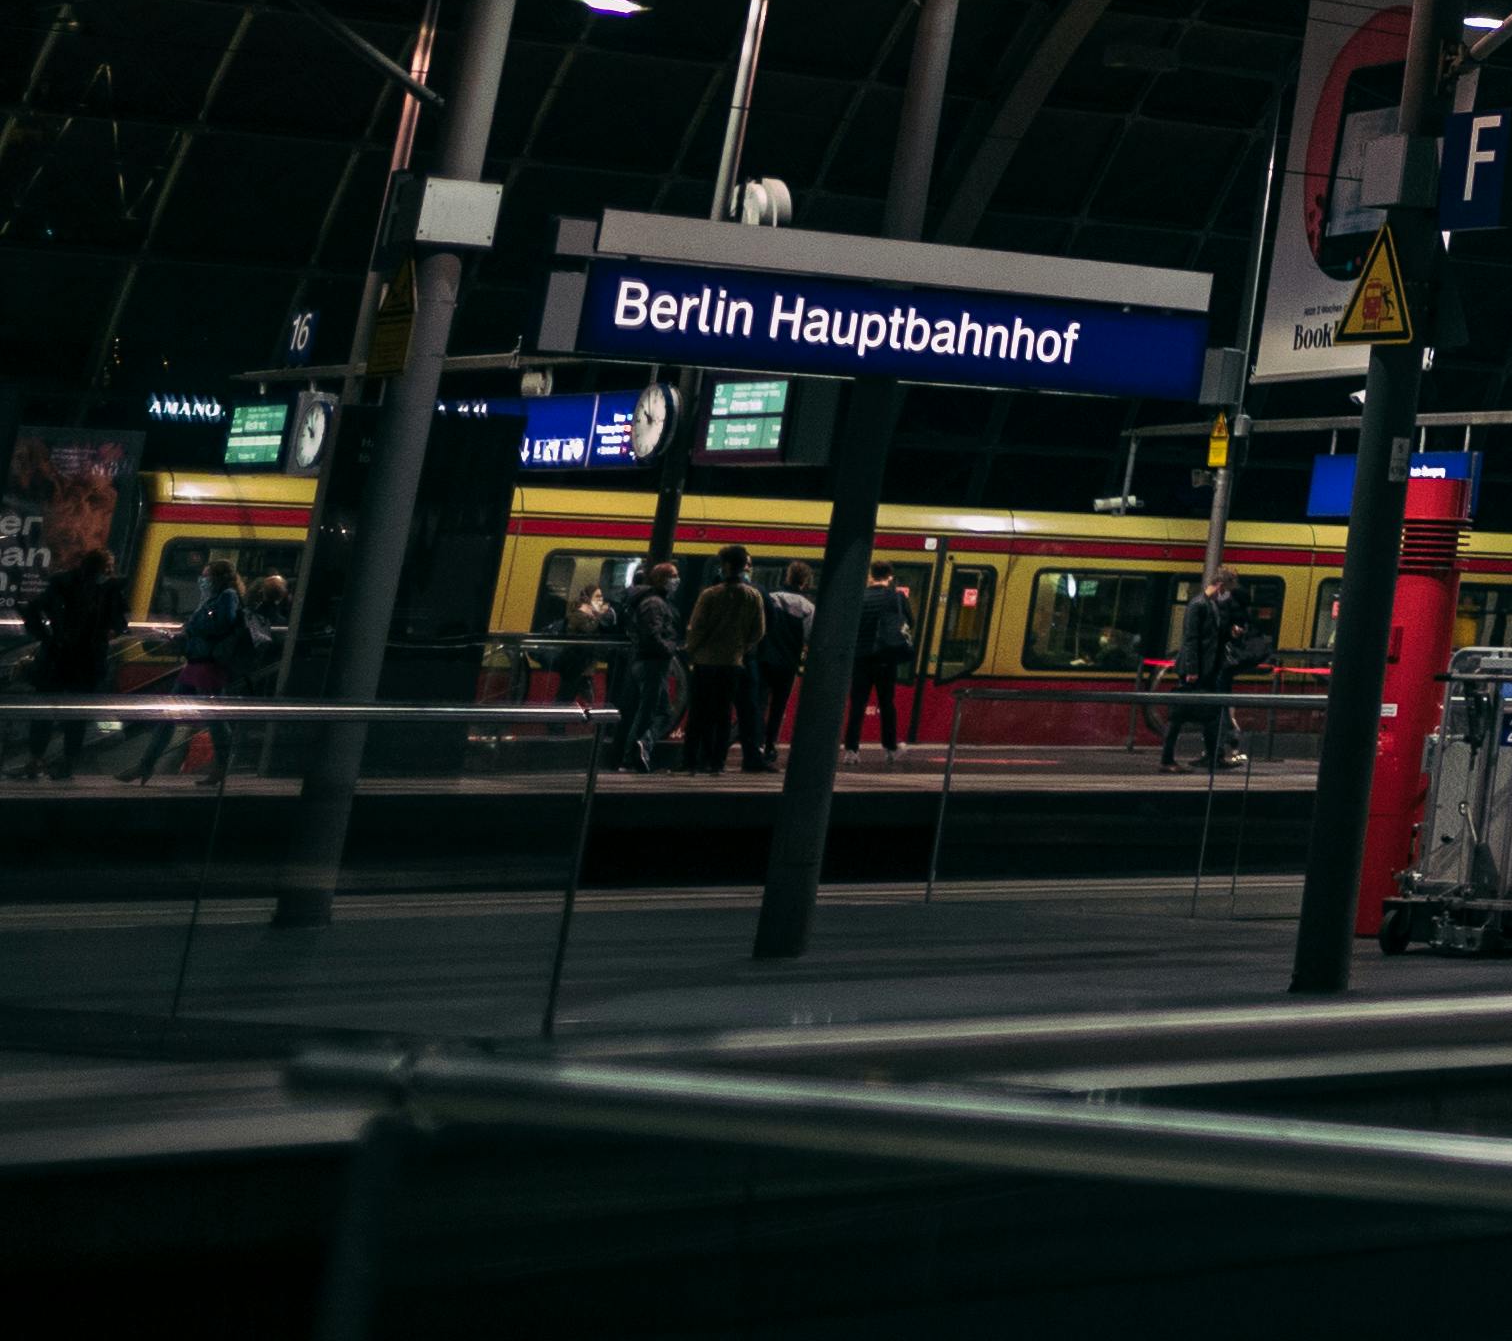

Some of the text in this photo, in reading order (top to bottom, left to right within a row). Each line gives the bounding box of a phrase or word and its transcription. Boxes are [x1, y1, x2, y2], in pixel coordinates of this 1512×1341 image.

[1462, 114, 1502, 203] F
[289, 311, 313, 352] 16
[612, 278, 1081, 365] Berlin Hauptbahnhof
[1292, 320, 1342, 351] Book
